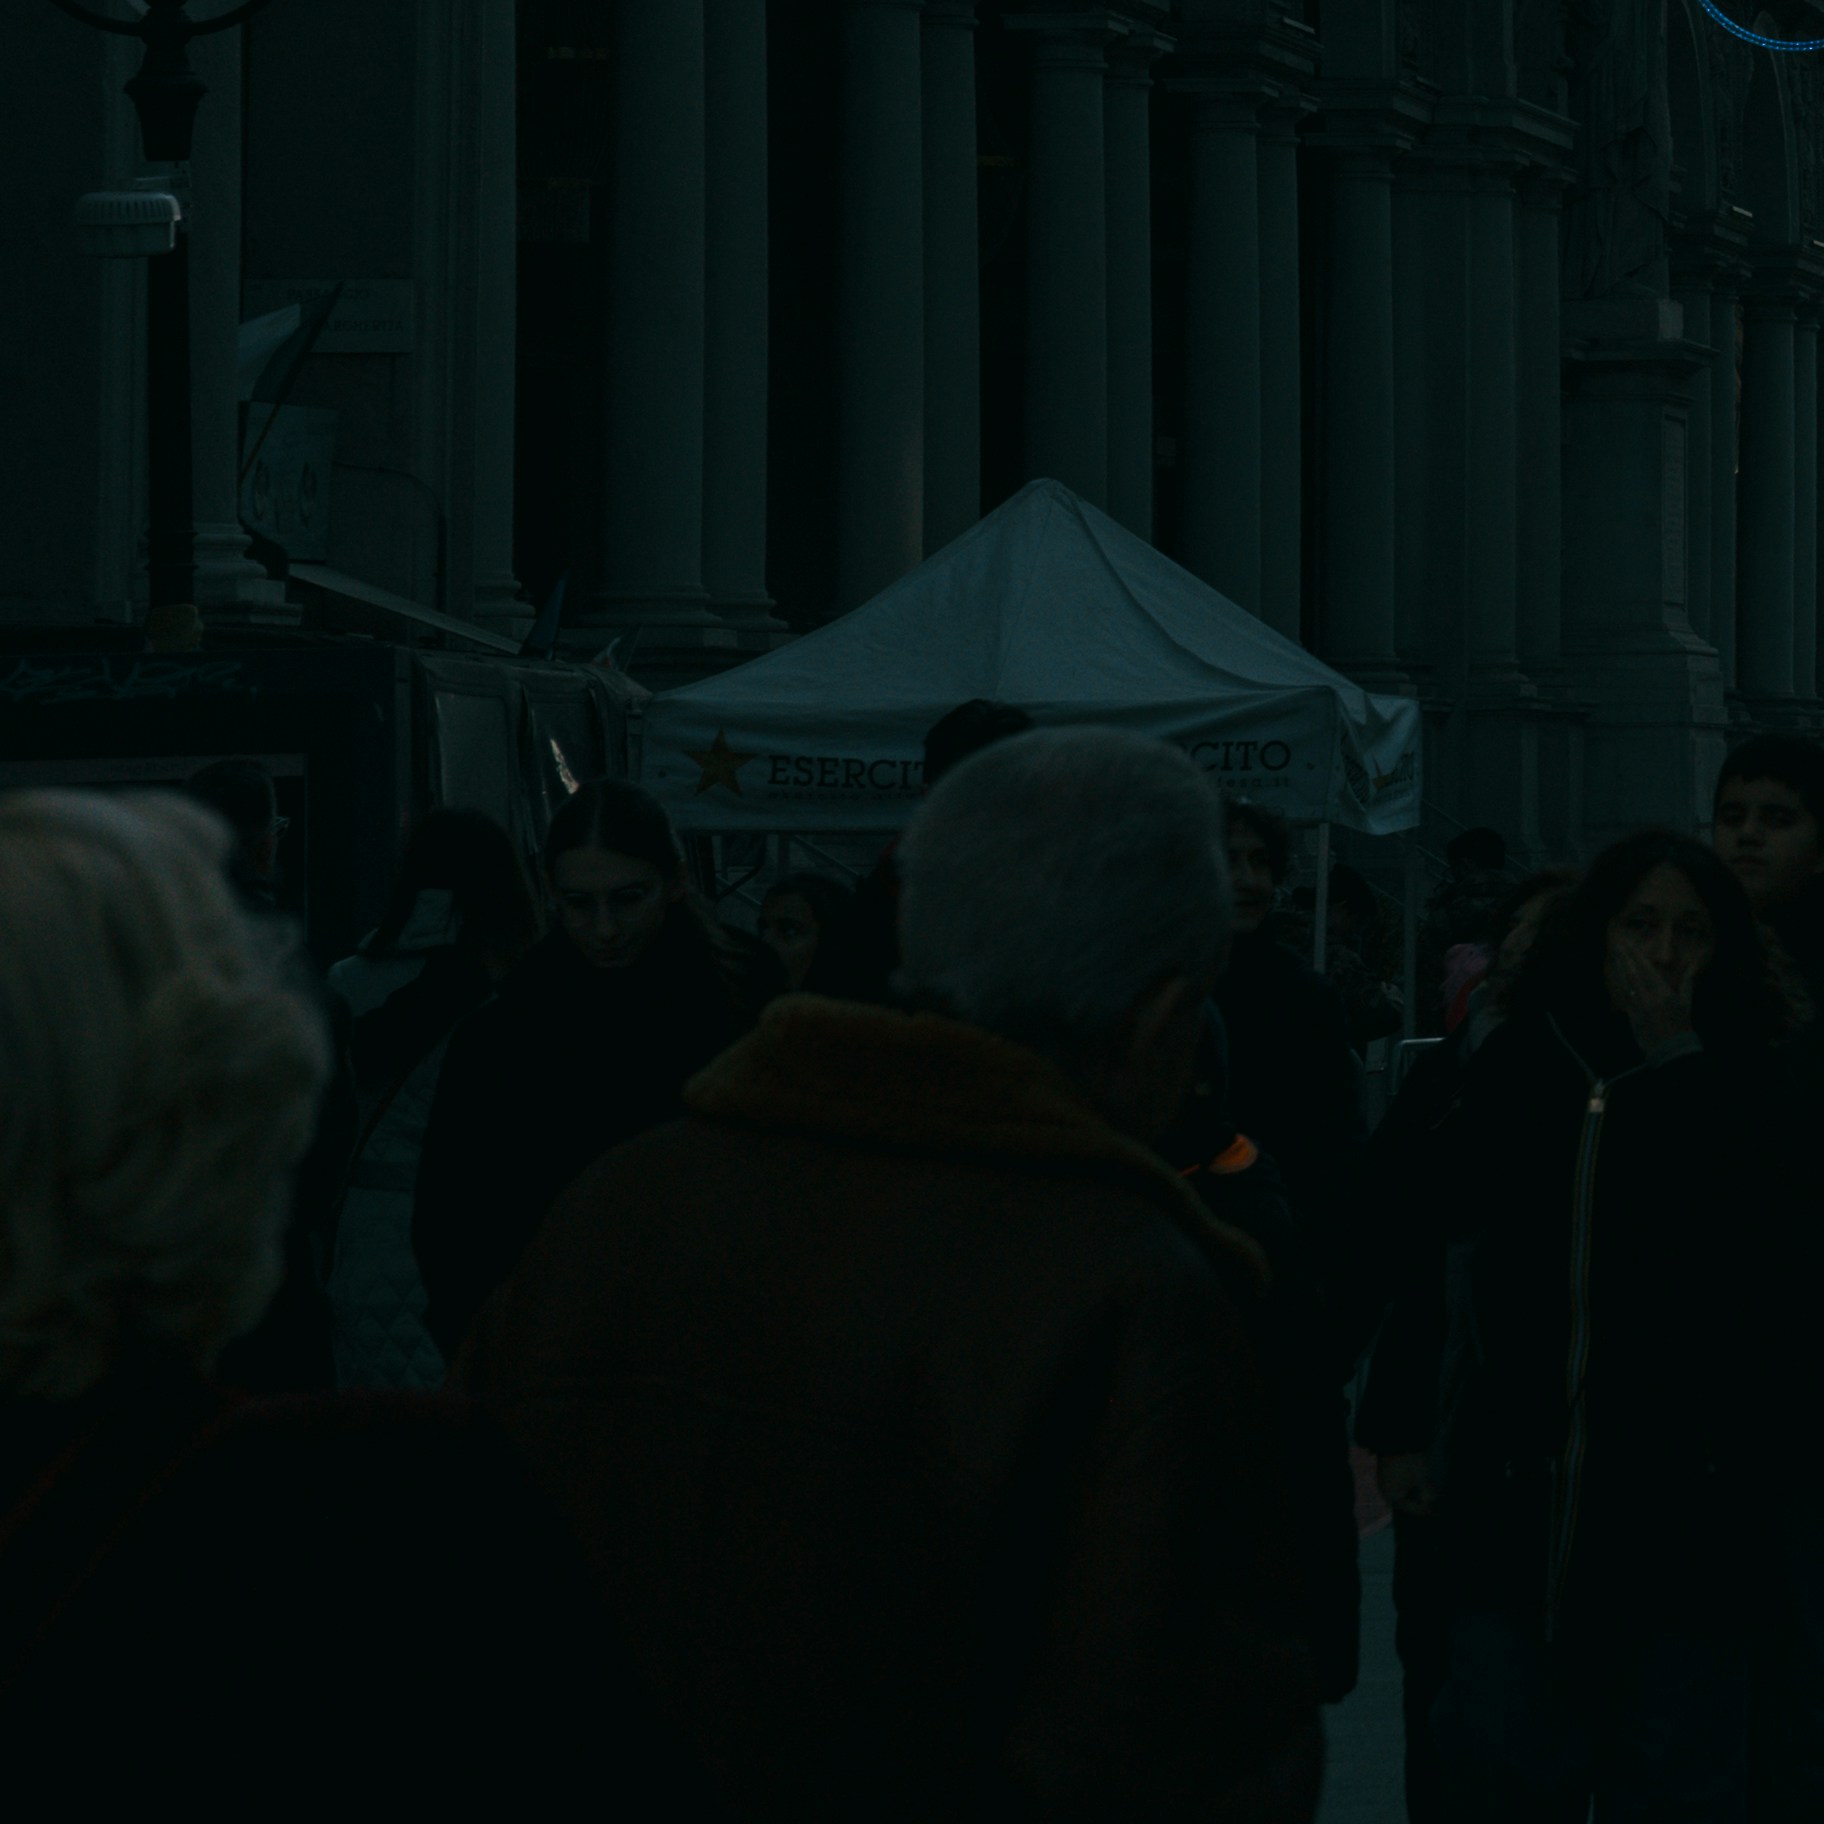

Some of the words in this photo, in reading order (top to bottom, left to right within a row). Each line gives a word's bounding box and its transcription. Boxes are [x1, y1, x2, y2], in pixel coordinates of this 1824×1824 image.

[286, 287, 370, 301] PASSAGIO
[320, 319, 404, 333] ARGHERITA
[768, 755, 926, 790] ESERCIT
